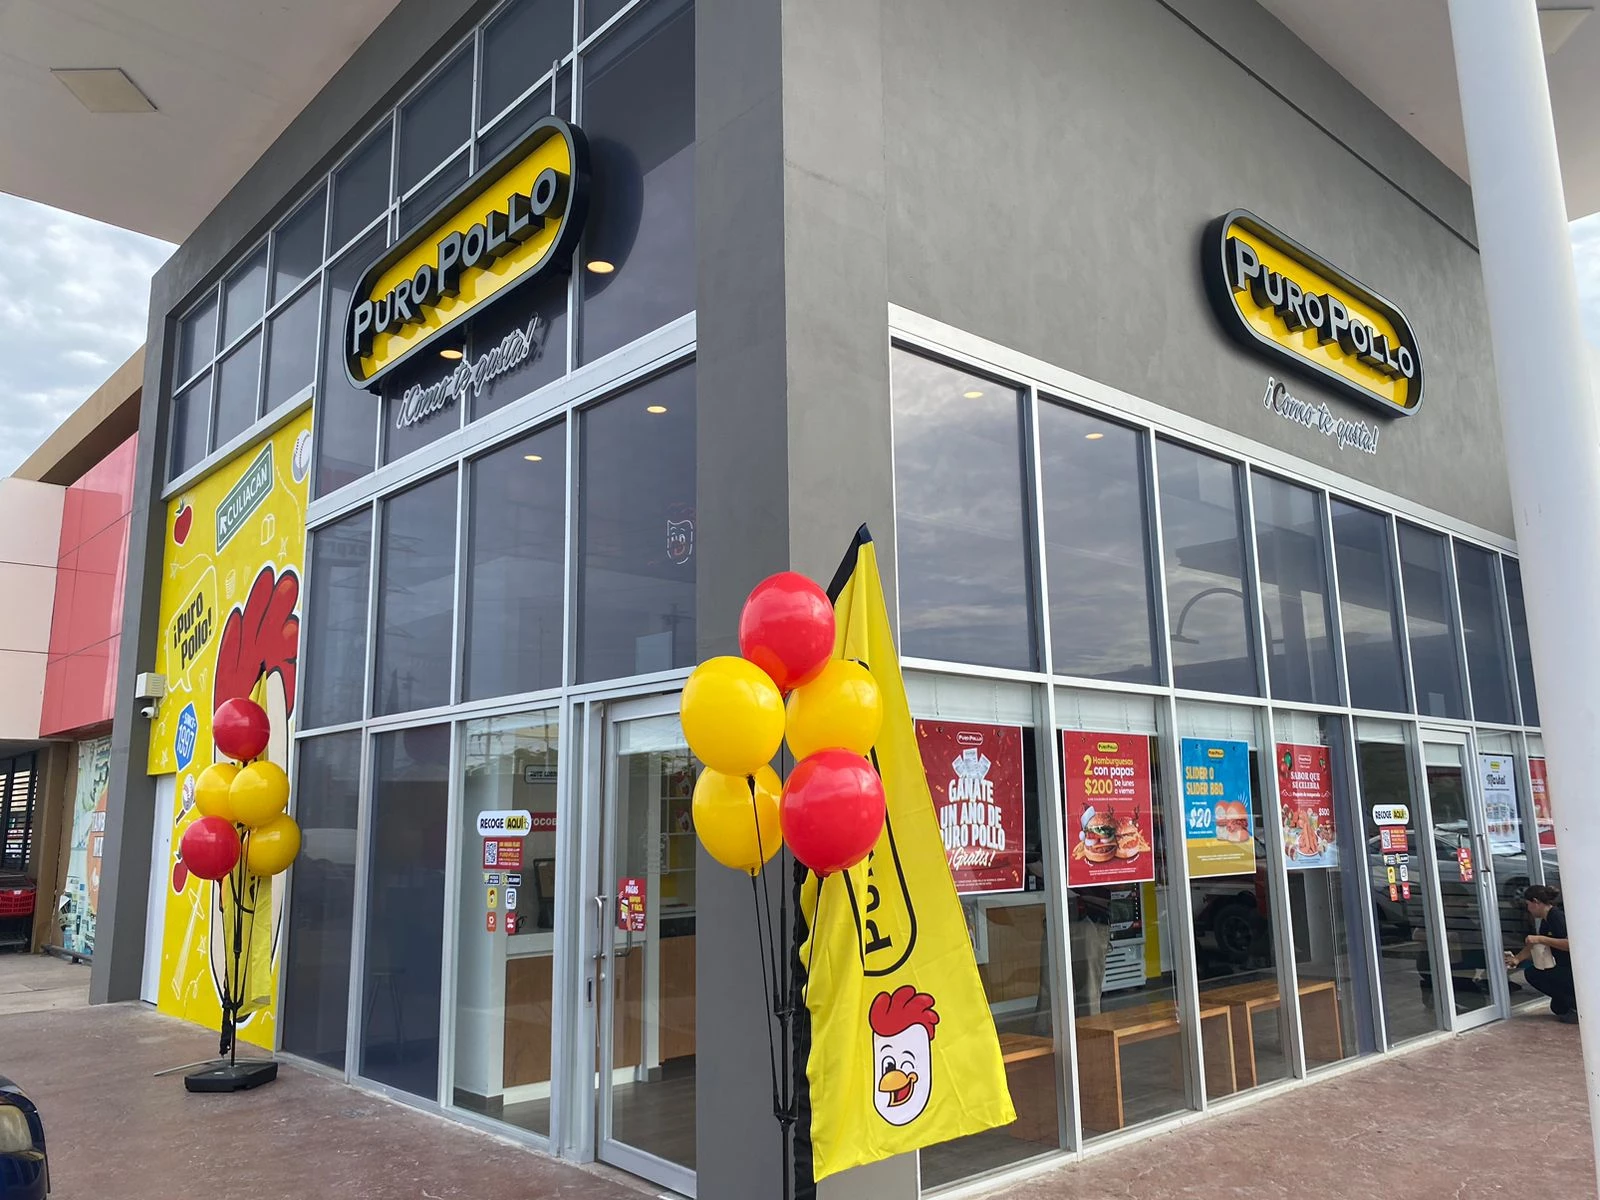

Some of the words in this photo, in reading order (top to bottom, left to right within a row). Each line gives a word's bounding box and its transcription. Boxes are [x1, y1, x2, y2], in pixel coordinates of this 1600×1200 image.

[226, 464, 268, 526] CULIACÁN
[177, 724, 194, 759] 1997
[1083, 754, 1093, 775] 2
[1092, 756, 1133, 767] Hamburguesas
[1093, 766, 1108, 776] con
[1110, 766, 1134, 779] papas
[1085, 777, 1113, 796] $200
[1186, 781, 1209, 796] SLIDER
[480, 818, 504, 829] RECOGE
[506, 815, 524, 829] AQUÍ
[940, 804, 957, 829] UN
[960, 801, 985, 826] AÑO
[987, 804, 1002, 829] DE
[1189, 807, 1212, 829] $20
[971, 824, 1006, 851] POLLO
